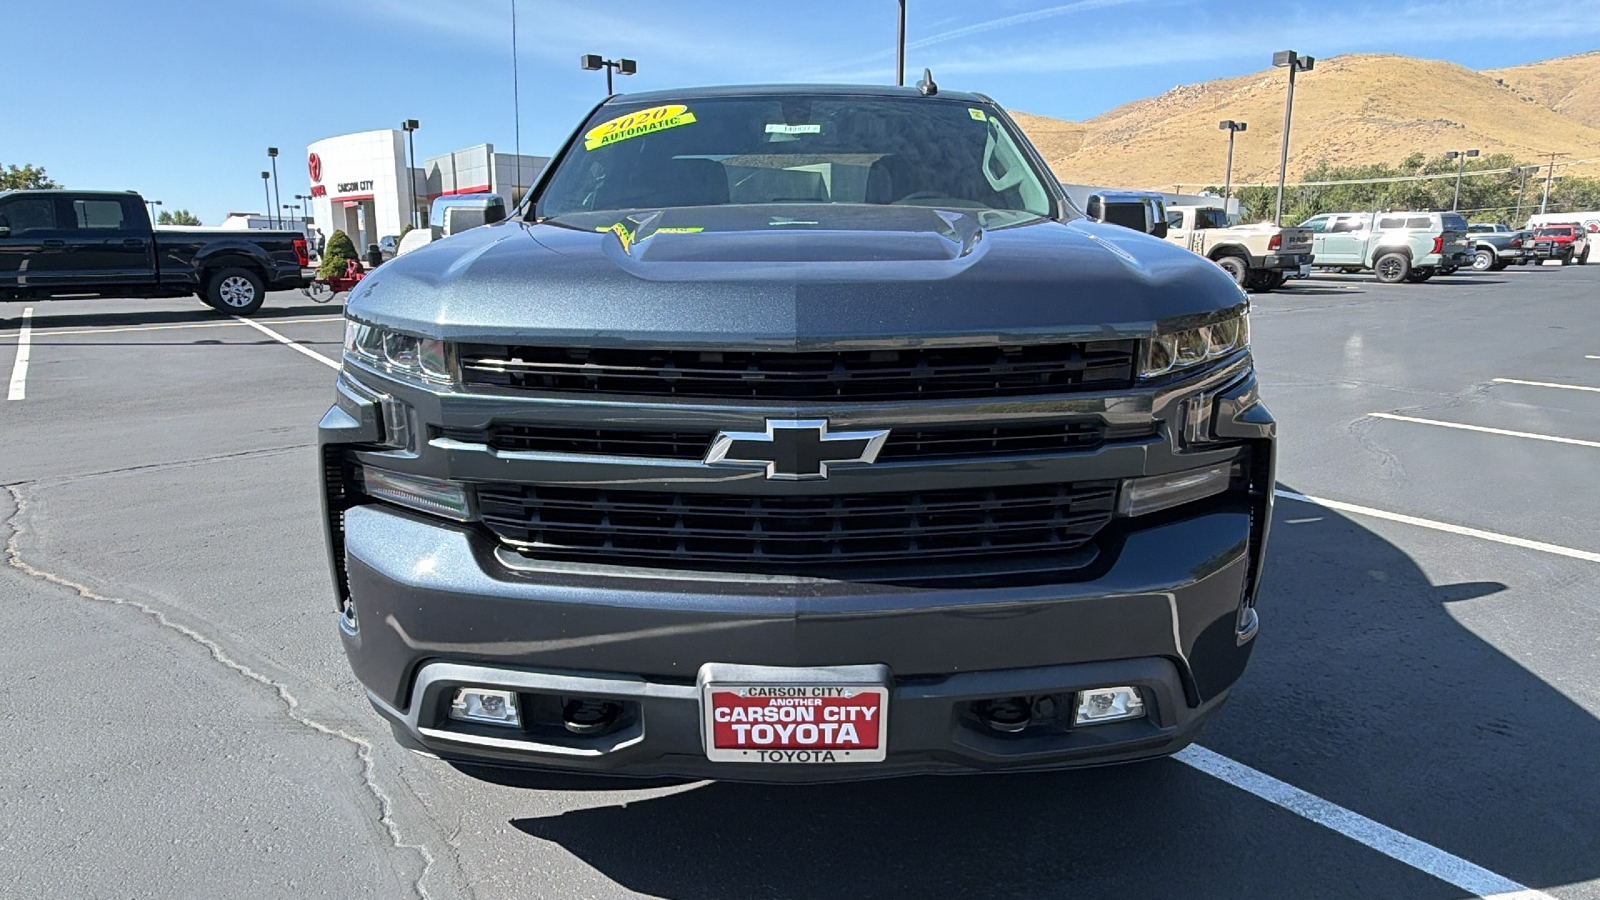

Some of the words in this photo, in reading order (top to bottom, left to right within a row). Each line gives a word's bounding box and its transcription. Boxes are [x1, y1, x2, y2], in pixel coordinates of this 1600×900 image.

[603, 107, 668, 135] 2020
[601, 117, 678, 143] AUTOMATIC
[360, 180, 373, 190] CITY
[748, 687, 807, 697] CARSON
[812, 687, 844, 697] CITY
[769, 698, 822, 706] ANOTHER
[714, 706, 814, 723] CARSON
[823, 706, 877, 721] CITY
[731, 723, 860, 744] TOYOTA
[757, 750, 836, 763] TOYOTA
